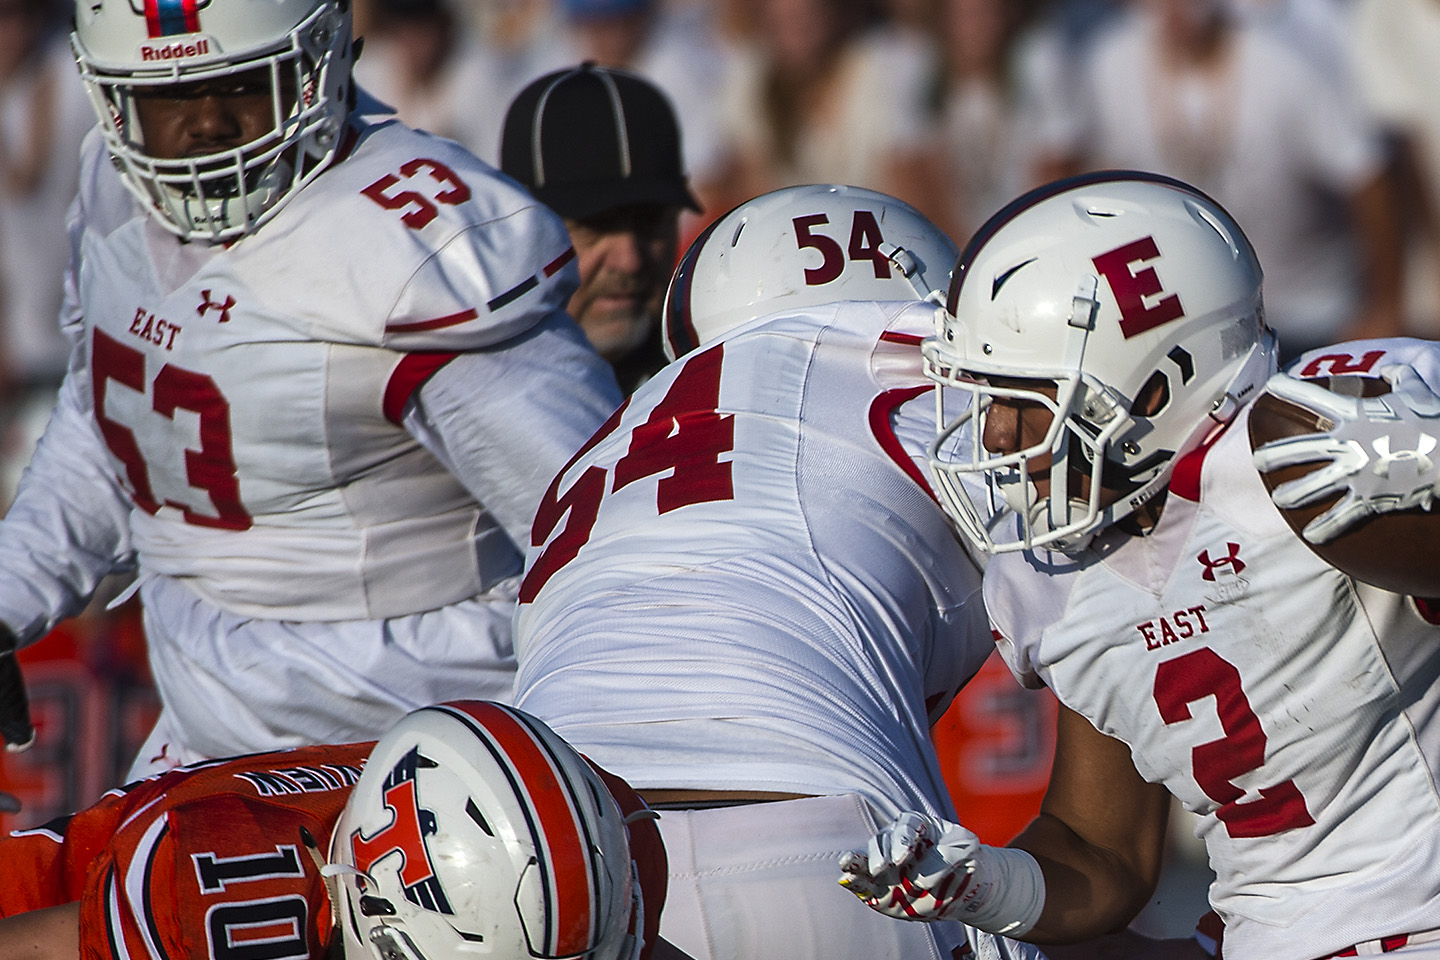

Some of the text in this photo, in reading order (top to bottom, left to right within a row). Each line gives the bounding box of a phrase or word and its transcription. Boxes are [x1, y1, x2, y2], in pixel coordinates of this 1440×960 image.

[141, 40, 210, 61] Riddell
[360, 157, 472, 231] 53
[791, 210, 892, 286] 54
[1092, 235, 1185, 340] E
[129, 306, 184, 352] EAST
[91, 327, 252, 532] 53
[517, 341, 736, 607] 54
[1136, 604, 1211, 652] EAST
[233, 758, 369, 797] VIEW
[1153, 646, 1317, 839] 2
